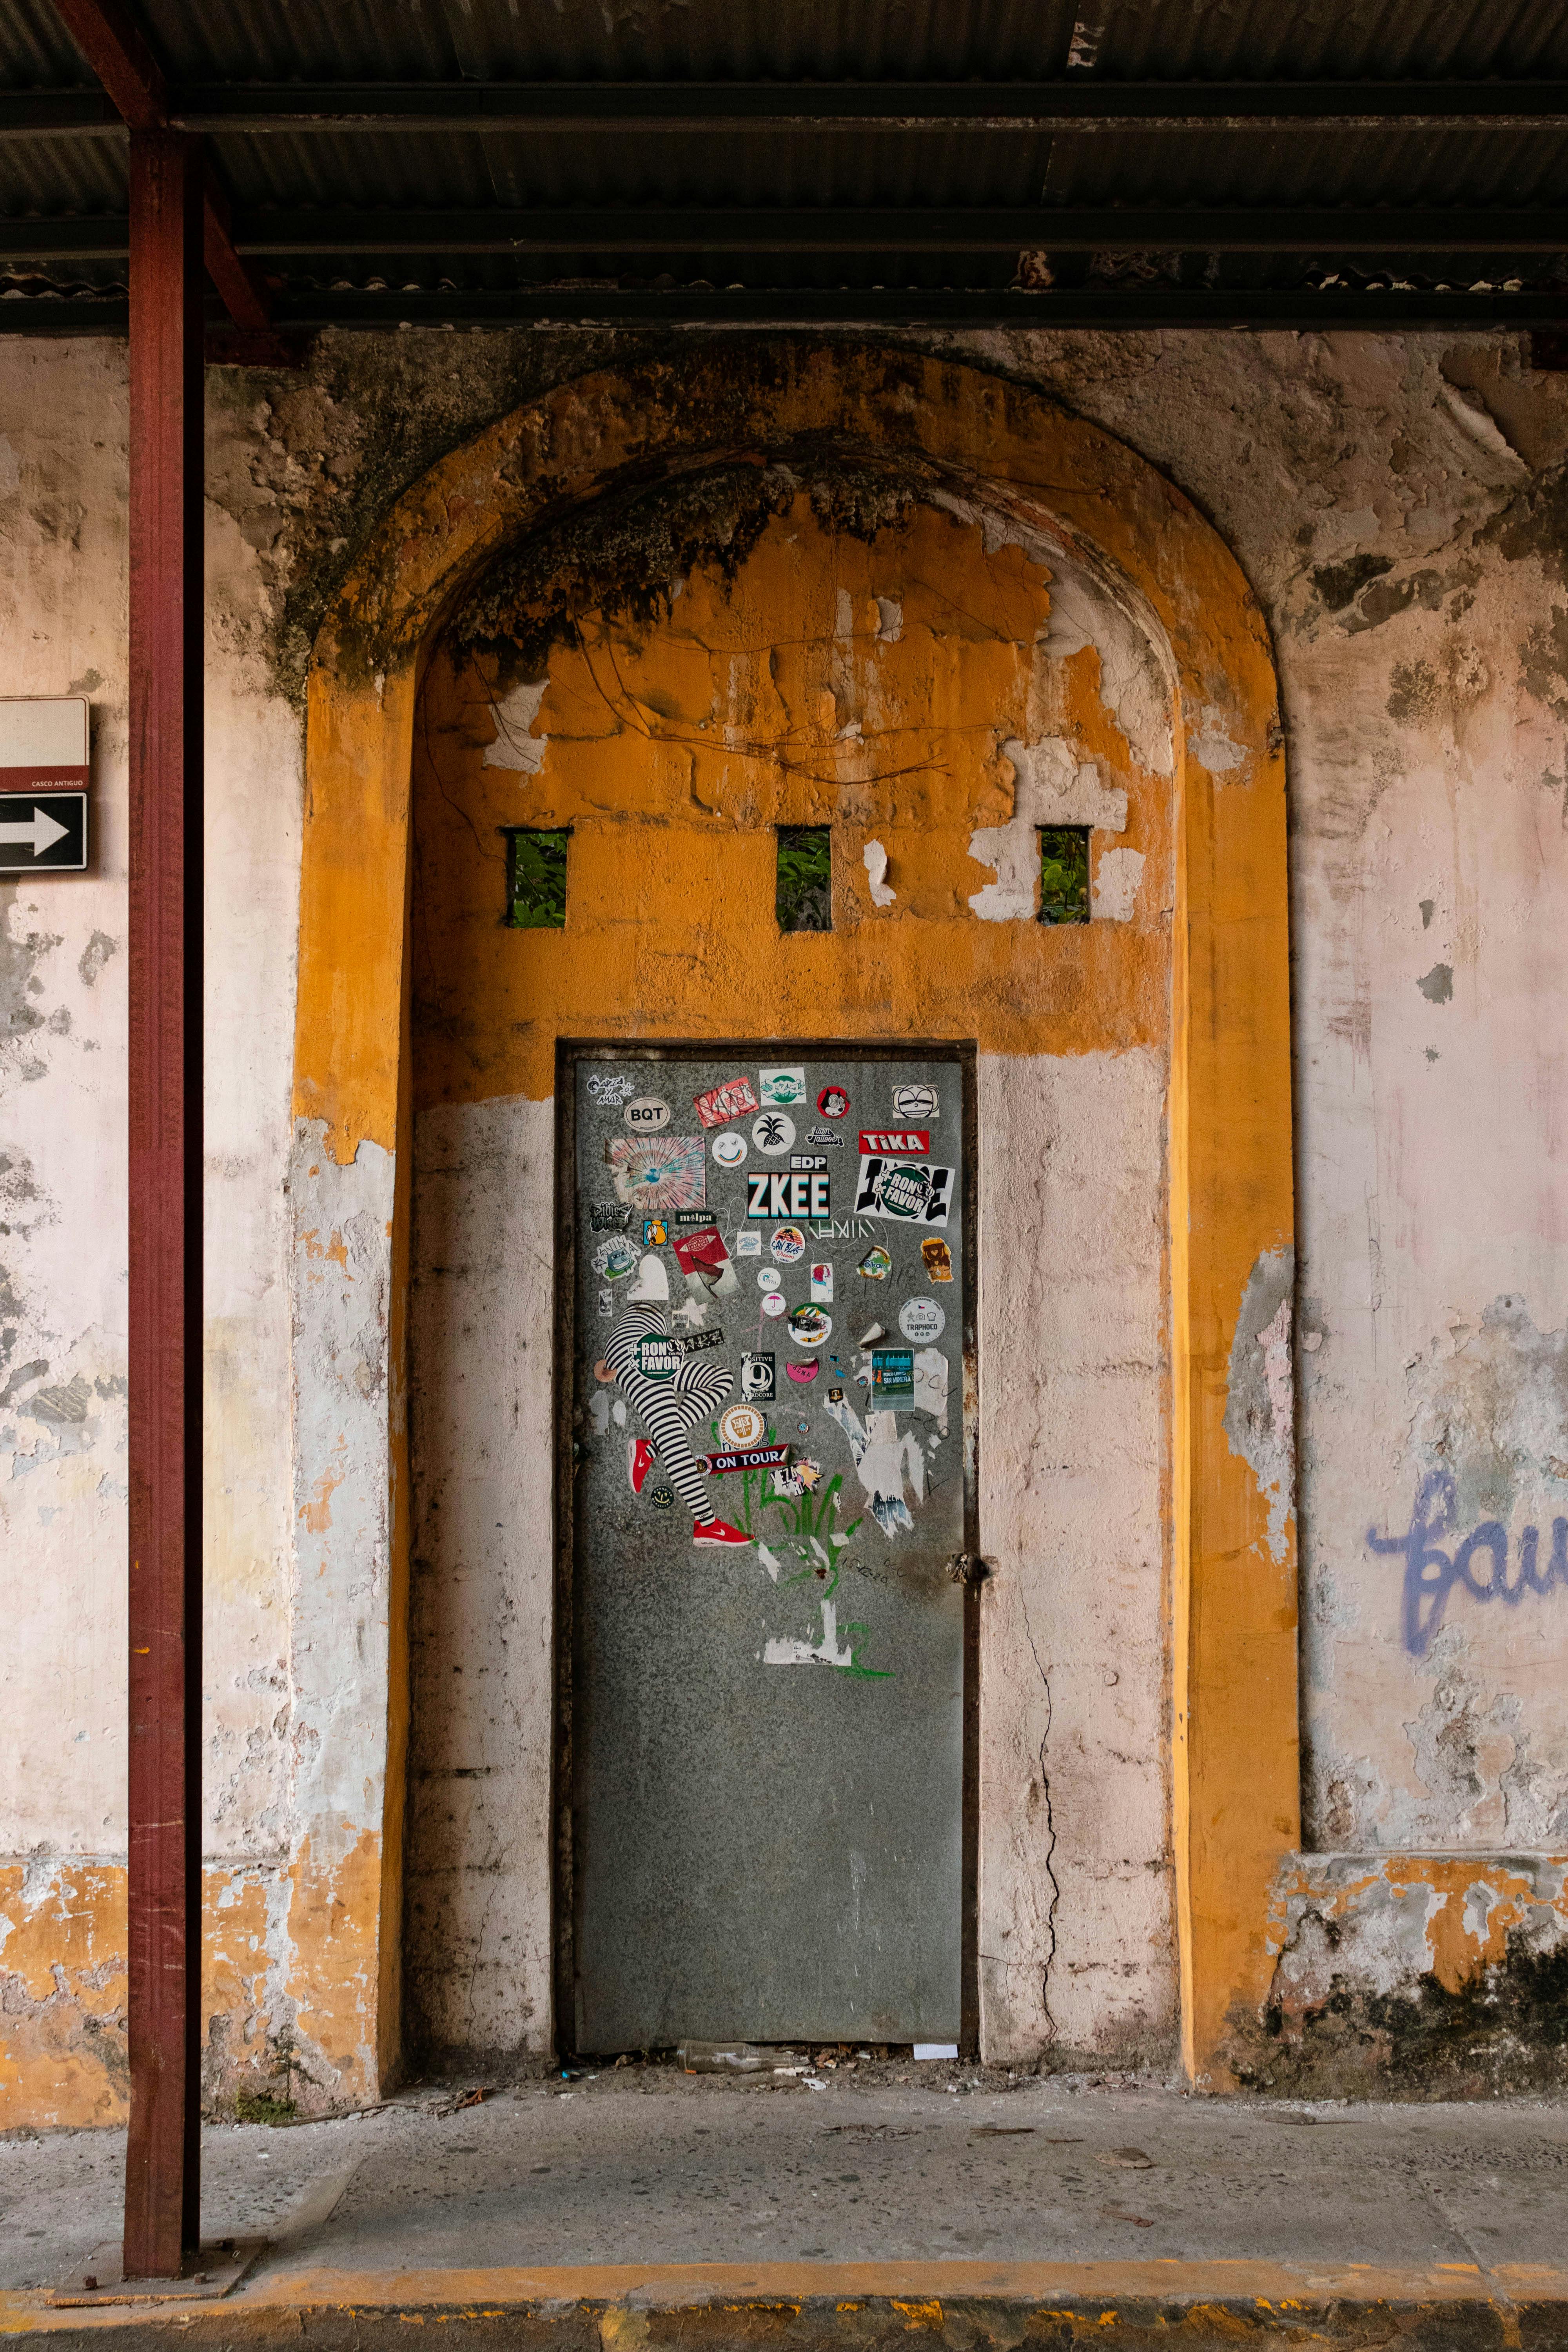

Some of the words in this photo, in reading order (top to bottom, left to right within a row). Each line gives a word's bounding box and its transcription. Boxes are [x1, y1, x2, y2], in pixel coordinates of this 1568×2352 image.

[631, 1107, 663, 1121] BQT
[791, 1156, 826, 1169] EDP
[890, 1173, 918, 1195] RON
[748, 1174, 829, 1217] ZKEE
[884, 1186, 924, 1213] FAVOR
[688, 1240, 709, 1250] FREIBURG
[771, 1240, 785, 1251] SAN
[784, 1243, 804, 1254] BLAS
[776, 1250, 795, 1259] Dreams
[641, 1342, 667, 1356] RON
[642, 1356, 681, 1370] FAVOR
[790, 1363, 811, 1377] ALMA
[716, 1457, 737, 1469] ON
[740, 1451, 780, 1466] TOUR
